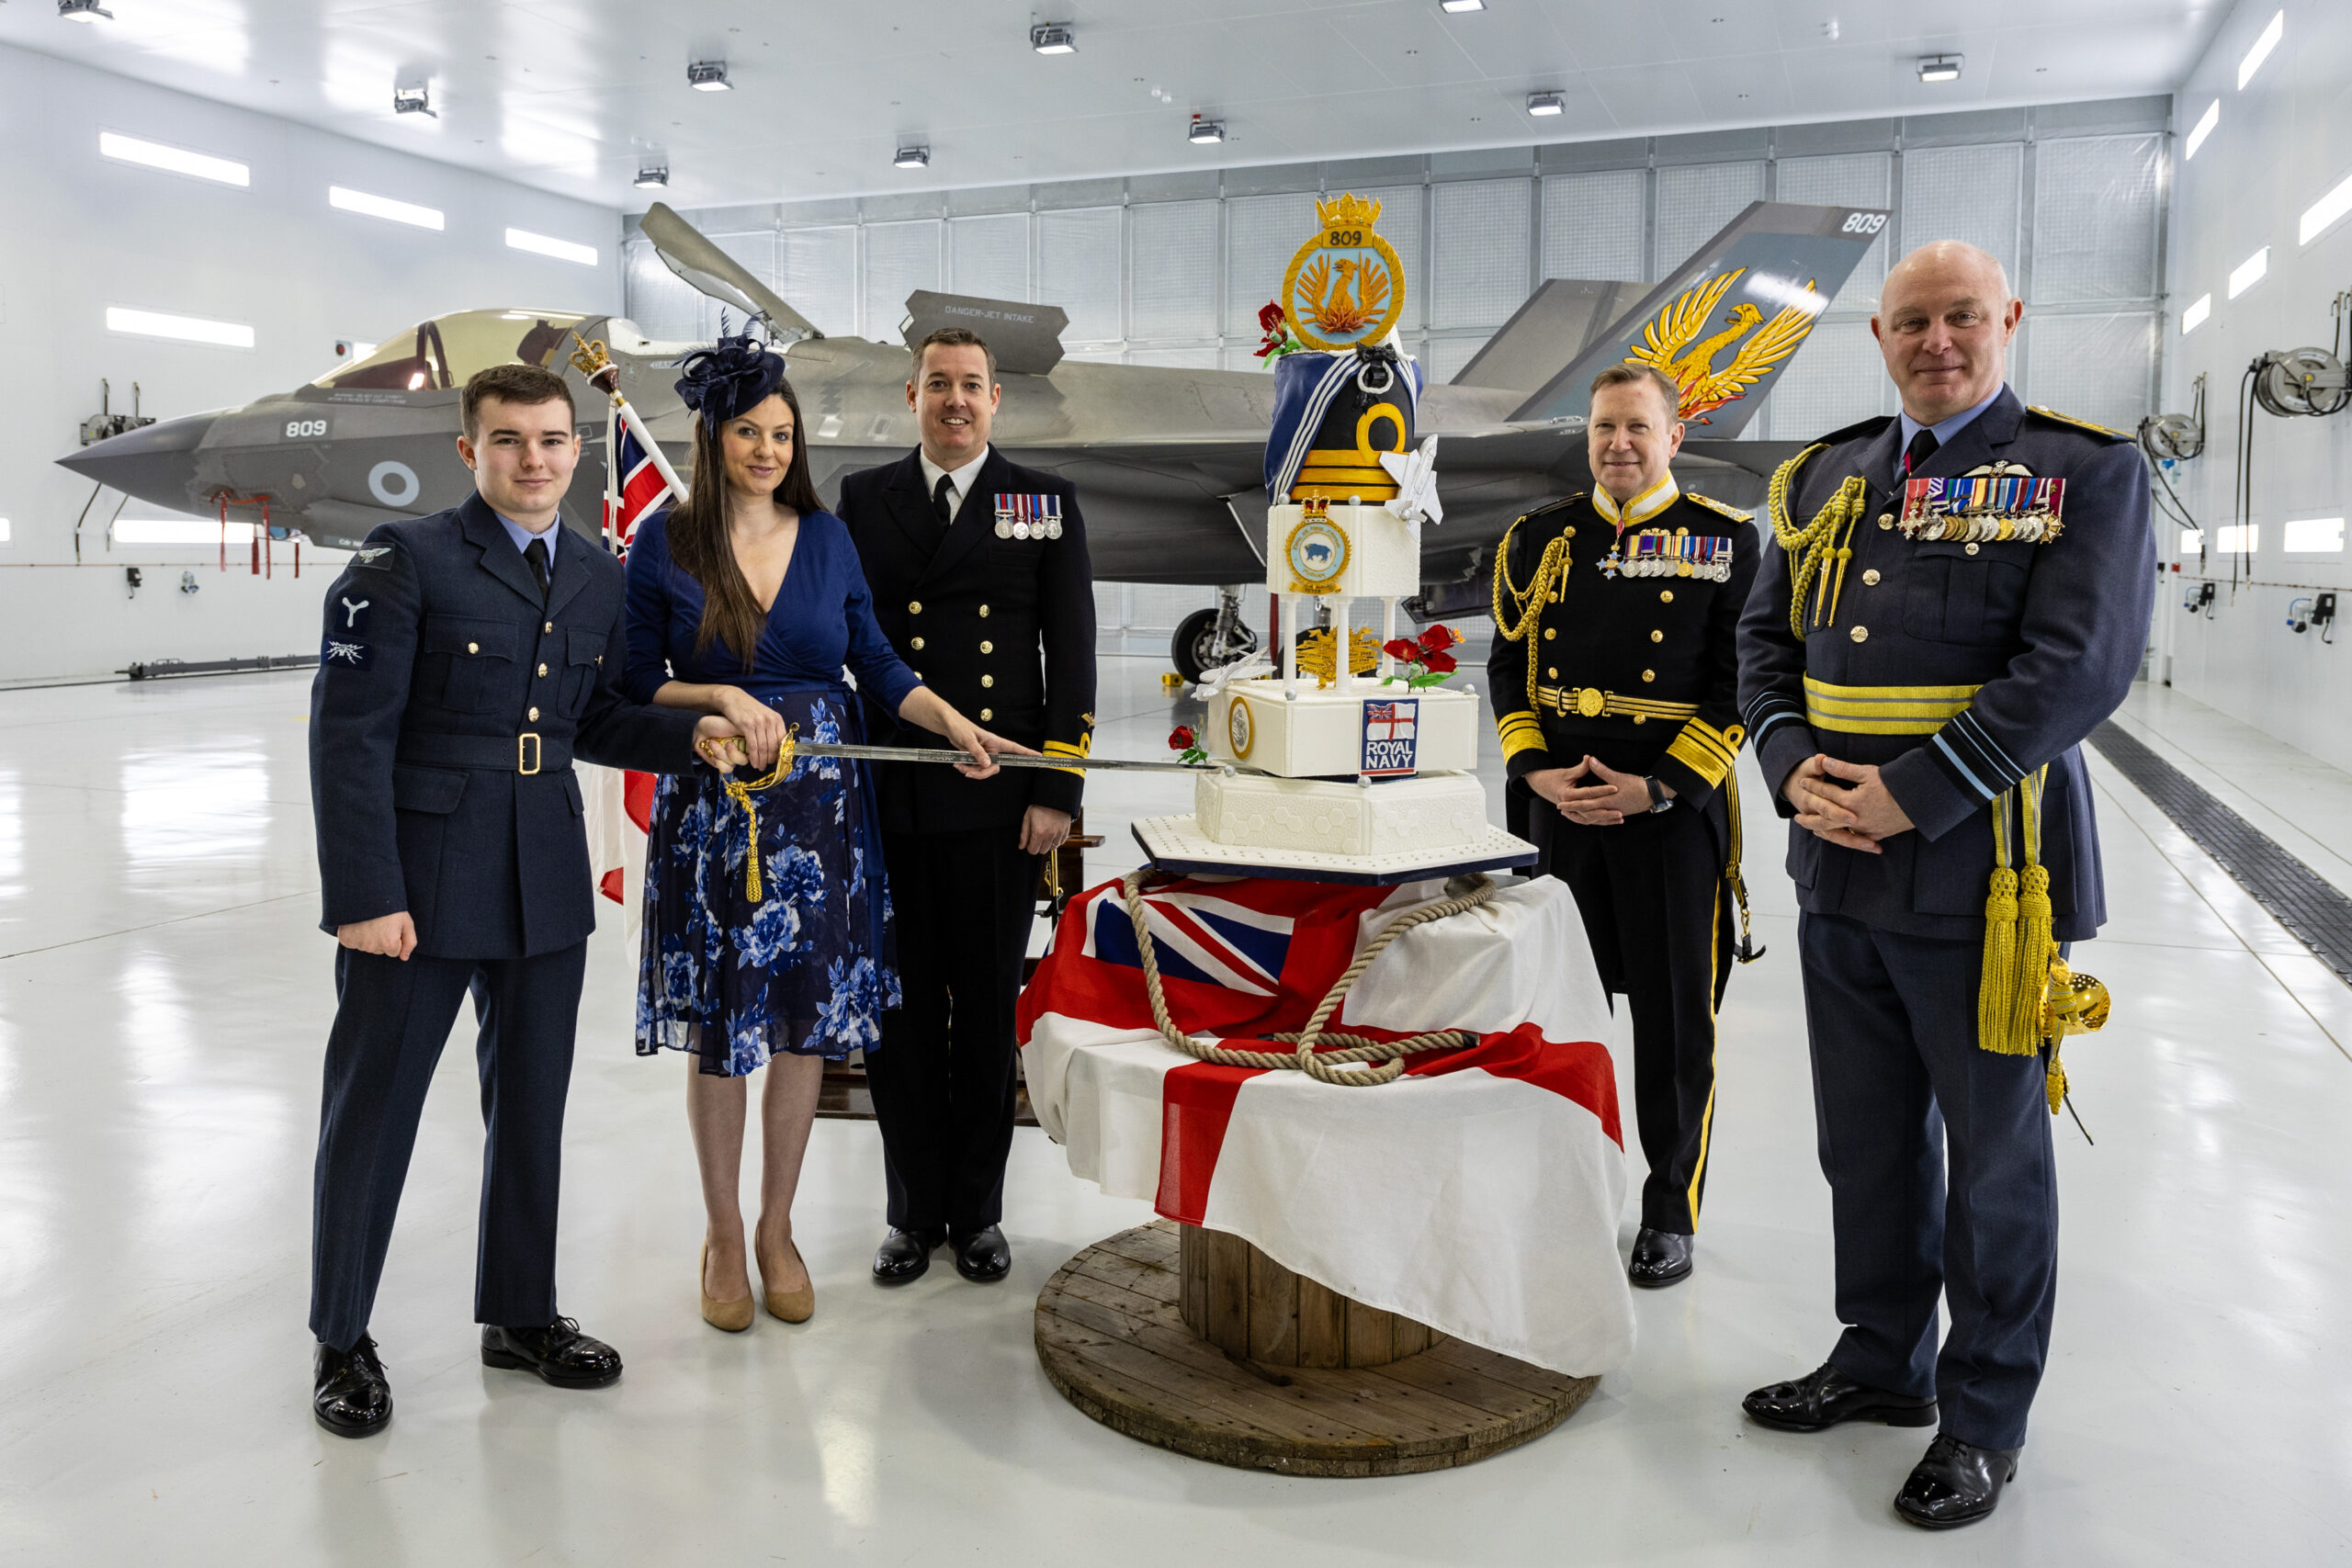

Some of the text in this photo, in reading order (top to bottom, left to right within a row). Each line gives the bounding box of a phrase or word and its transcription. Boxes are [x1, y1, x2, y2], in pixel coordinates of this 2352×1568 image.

[1842, 212, 1887, 234] 809
[1329, 231, 1363, 245] 809
[1003, 312, 1035, 323] INTAKE
[287, 420, 327, 437] 809
[1366, 740, 1413, 755] ROYAL
[1365, 754, 1412, 769] NAVY
